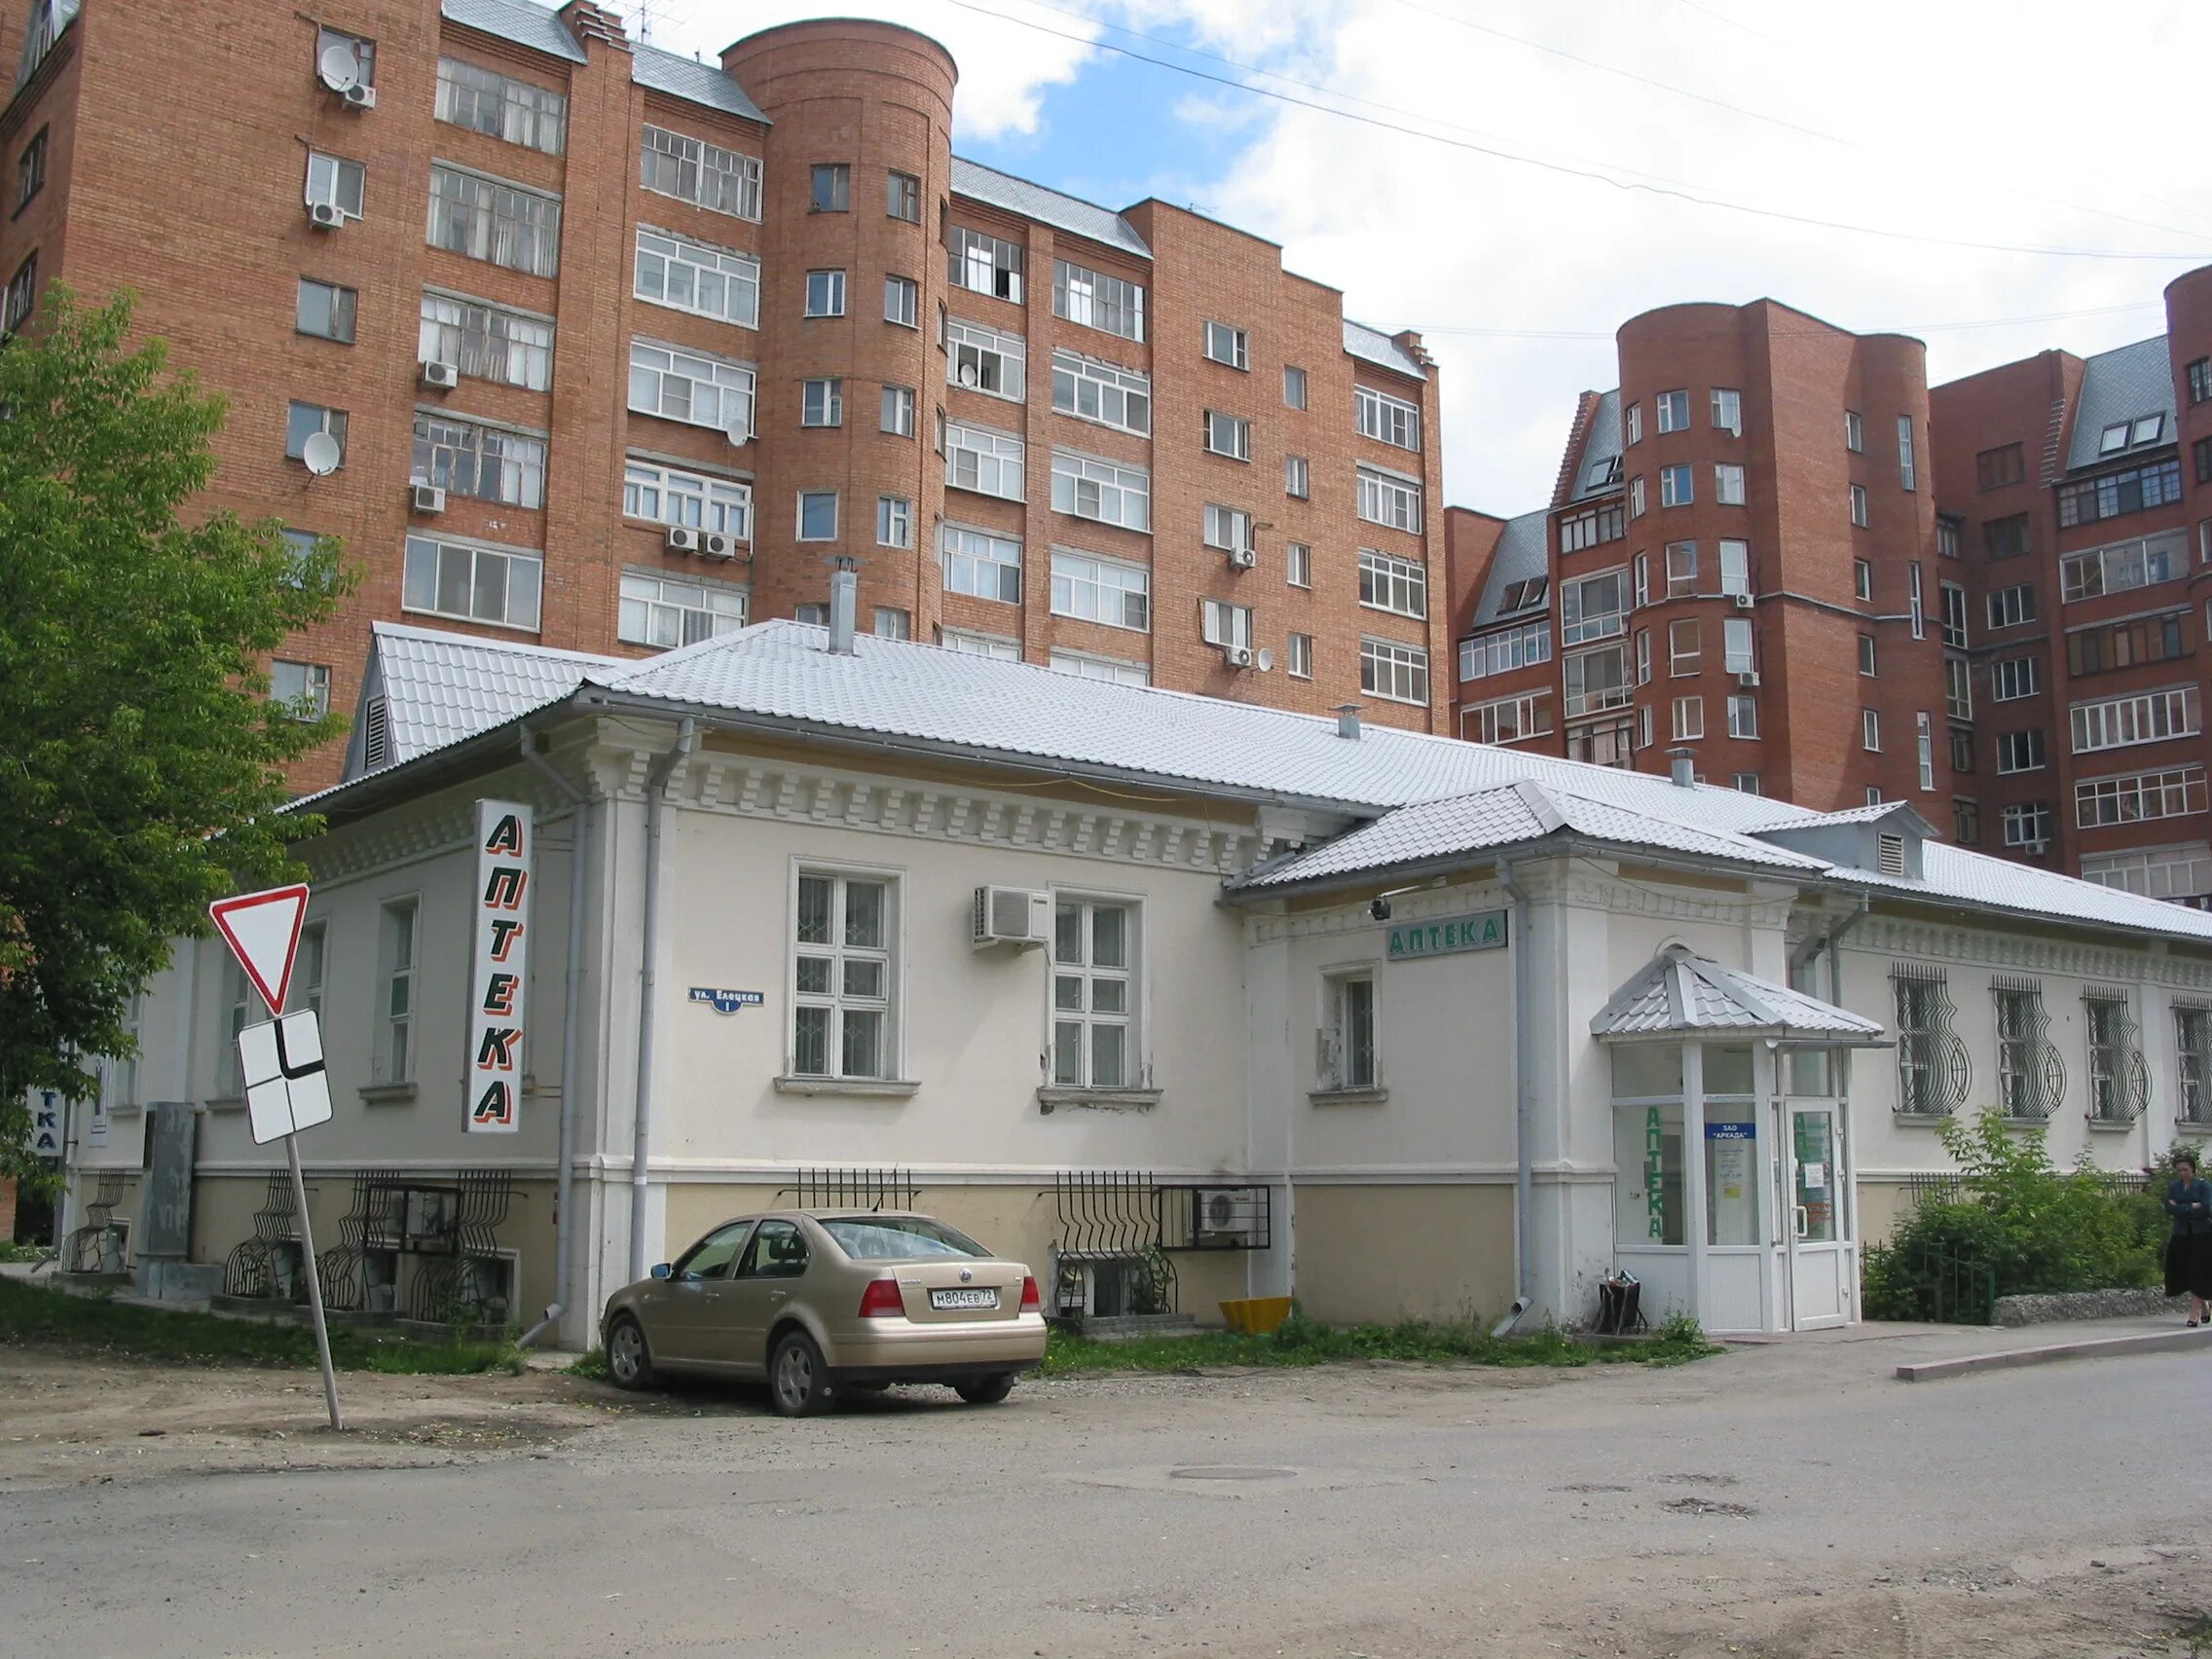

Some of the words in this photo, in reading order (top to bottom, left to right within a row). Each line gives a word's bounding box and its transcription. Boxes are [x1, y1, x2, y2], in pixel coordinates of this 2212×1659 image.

[474, 814, 528, 1125] АПТЕКА
[1389, 918, 1500, 955] АПТЕКА
[1645, 1106, 1664, 1237] АПТЕКА
